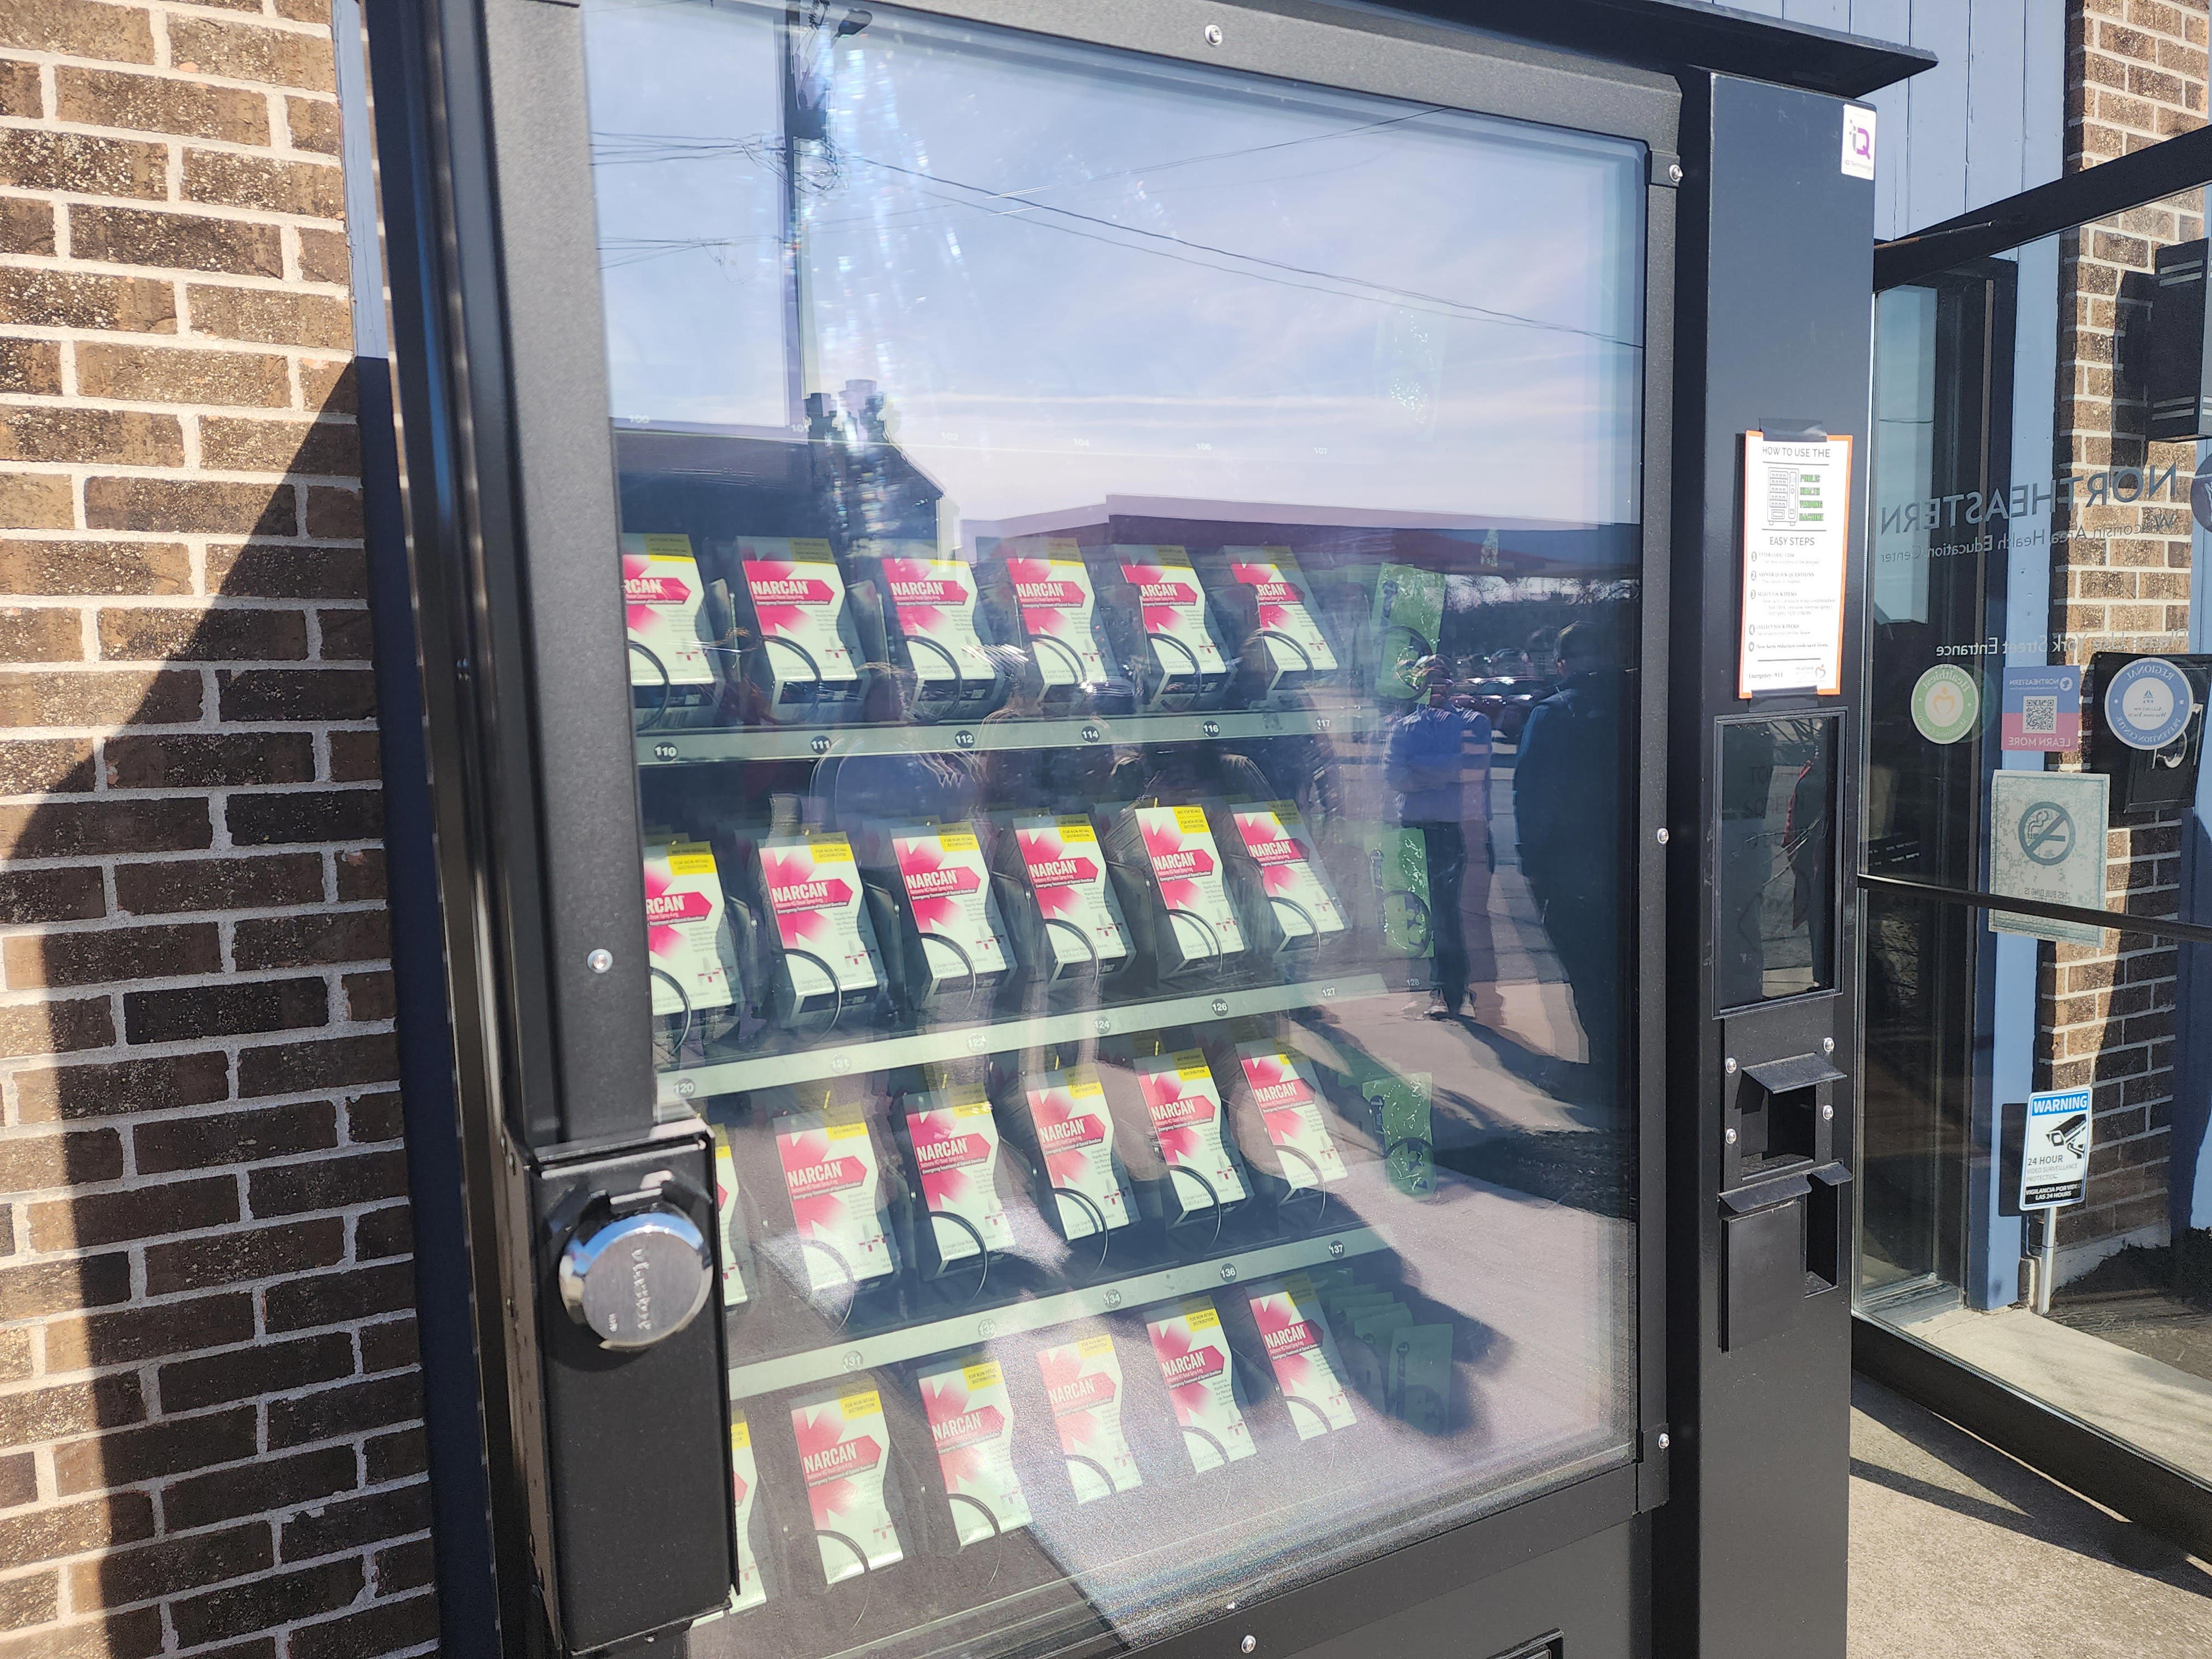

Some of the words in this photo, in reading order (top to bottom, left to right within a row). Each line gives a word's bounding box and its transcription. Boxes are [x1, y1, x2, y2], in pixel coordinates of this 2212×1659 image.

[941, 432, 958, 441] 102
[1313, 447, 1328, 455] 107
[1762, 446, 1780, 456] HOW
[1782, 447, 1792, 456] TO
[1795, 448, 1810, 457] USE
[1813, 448, 1830, 457] THE
[1800, 474, 1821, 483] PUBLIC
[1770, 536, 1788, 546] EASY
[1789, 537, 1815, 546] STEPS
[624, 578, 662, 594] RCAN
[750, 580, 809, 595] NARCAN
[890, 582, 944, 595] NARCAN
[1016, 583, 1064, 597] NARCAN
[1140, 584, 1178, 596] ARCAN
[1256, 583, 1286, 596] RCAN
[1203, 724, 1220, 734] 116
[1316, 719, 1331, 729] 117
[955, 734, 974, 744] 112
[1082, 730, 1099, 740] 114
[811, 740, 830, 750] 111
[655, 746, 677, 758] 110
[1249, 841, 1292, 857] NARCAN
[1153, 852, 1196, 871] NARCAN
[1028, 860, 1077, 878] NARCAN
[905, 870, 958, 889] NARCAN
[771, 882, 828, 903] NARCAN
[645, 895, 685, 914] RCAN
[1322, 987, 1336, 997] 127
[1212, 1002, 1228, 1012] 126
[1094, 1020, 1110, 1030] 124
[674, 1082, 695, 1093] 120
[1255, 1082, 1297, 1103] NARCAN
[1150, 1099, 1196, 1121] NARCAN
[2033, 1095, 2088, 1113] WARNING
[1039, 1118, 1086, 1143] NARCAN
[916, 1138, 968, 1162] NARCAN
[2027, 1157, 2037, 1166] 24
[2039, 1155, 2064, 1165] HOUR
[787, 1161, 843, 1188] NARCAN
[2042, 1163, 2078, 1173] SURVEILLANCE
[1328, 1243, 1342, 1254] 137
[1221, 1268, 1236, 1277] 136
[1265, 1324, 1306, 1348] NARCAN
[844, 1356, 861, 1367] 131
[1162, 1351, 1206, 1377] NARCAN
[1048, 1378, 1096, 1405] NARCAN
[932, 1412, 982, 1441] NARCAN
[803, 1442, 857, 1474] NARCAN
